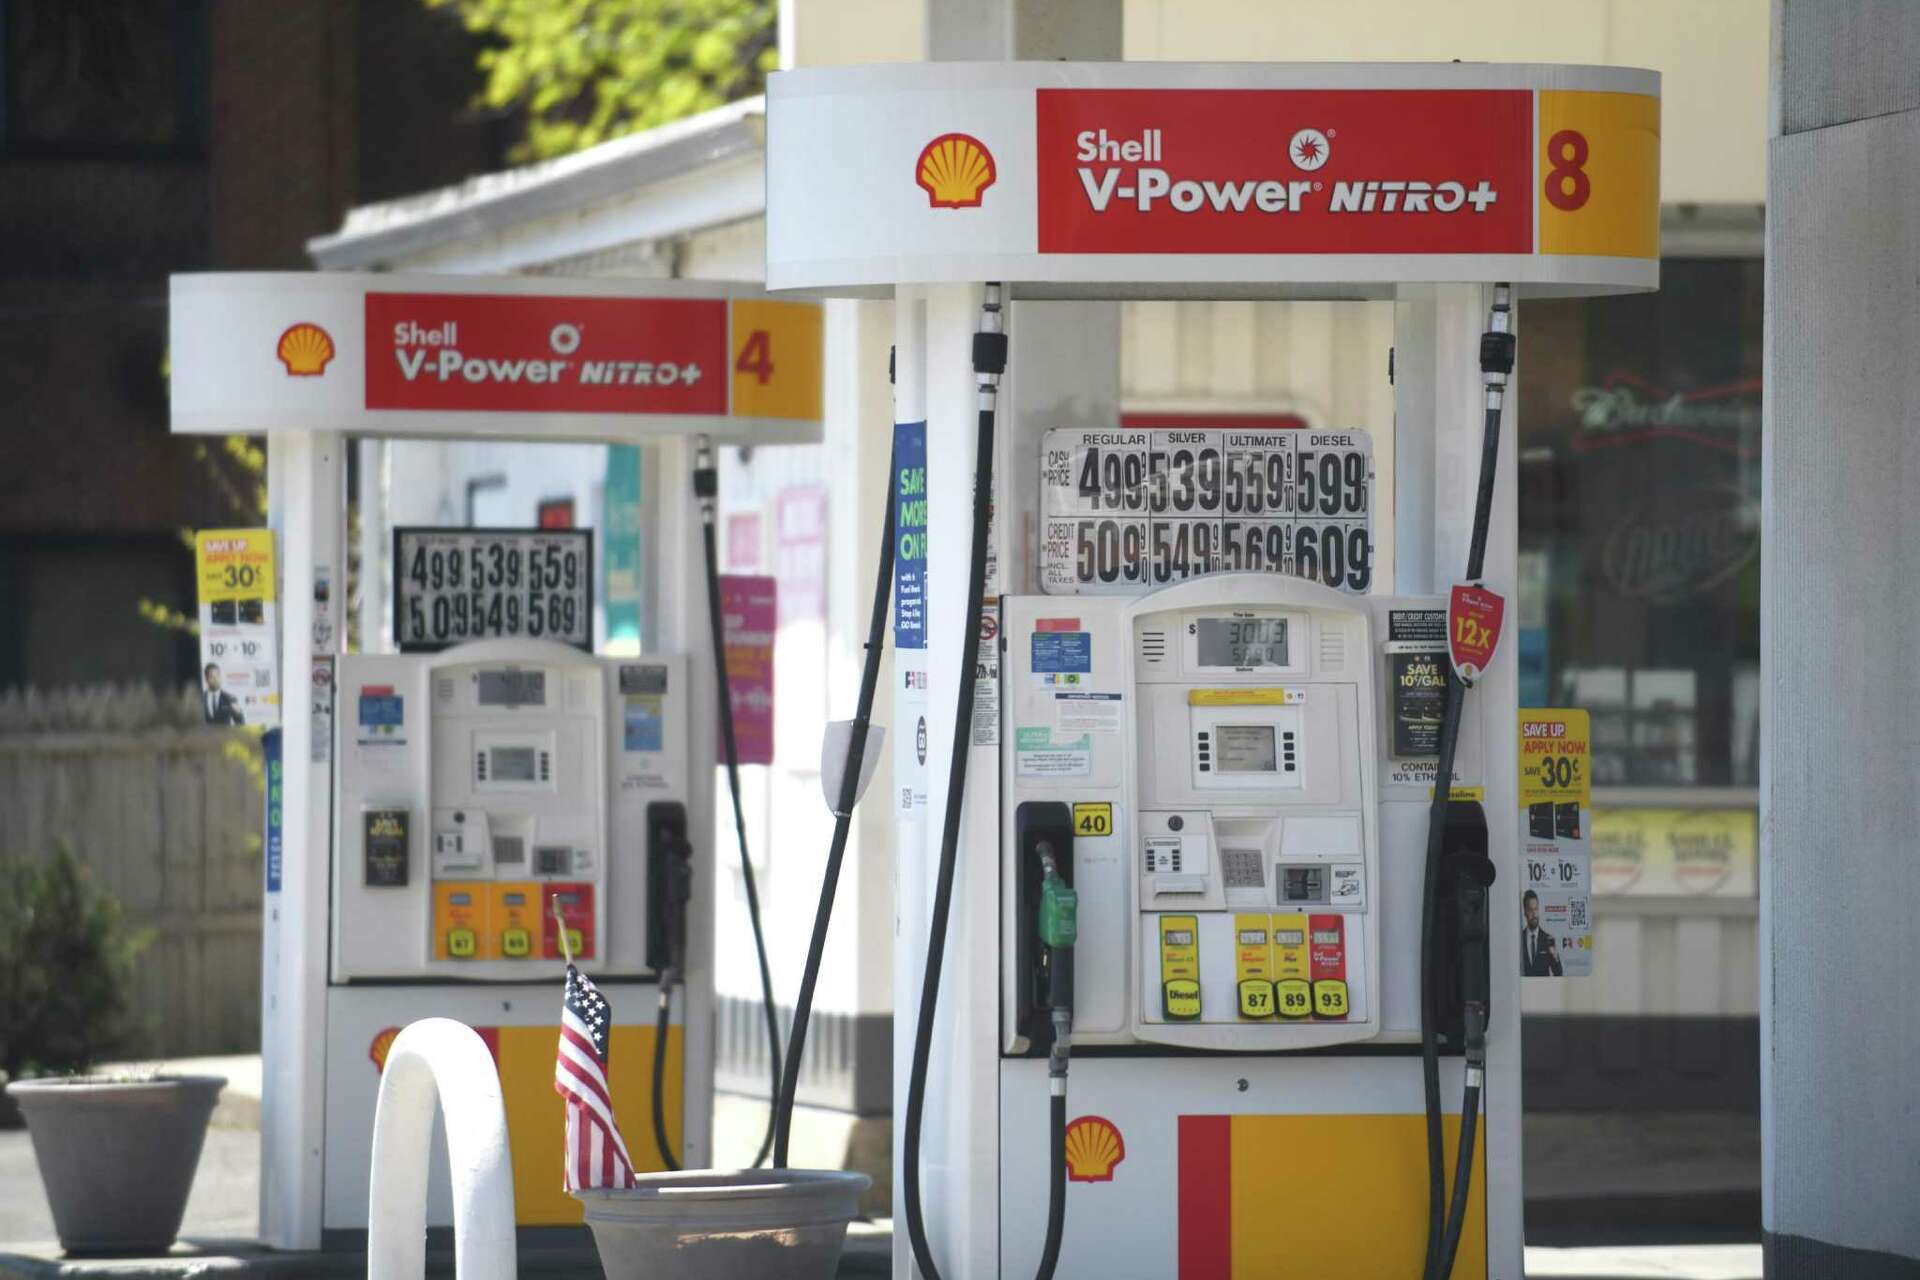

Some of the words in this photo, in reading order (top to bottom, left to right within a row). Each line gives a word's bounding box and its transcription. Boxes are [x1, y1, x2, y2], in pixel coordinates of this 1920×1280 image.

[1077, 129, 1161, 161] Shell
[1545, 129, 1590, 211] 8
[1077, 167, 1312, 212] V-Power
[394, 321, 457, 345] Shell
[736, 329, 774, 385] 4
[396, 349, 567, 383] V-Power
[1083, 434, 1146, 445] REGULAR
[1168, 432, 1206, 443] SILVER
[1230, 436, 1287, 446] ULTIMATE
[1310, 435, 1354, 446] DIESEL
[1048, 450, 1070, 468] CASH
[1048, 468, 1070, 487] PRICE
[1048, 523, 1075, 540] CREDIT
[1048, 541, 1069, 558] PRICE
[1189, 624, 1196, 634] $
[1407, 664, 1438, 675] SAVE
[1523, 723, 1547, 737] SAVE
[1550, 723, 1565, 737] UP
[1524, 741, 1553, 753] APPLY
[1558, 741, 1586, 753] NOW
[1080, 815, 1105, 832] 40
[1169, 989, 1199, 1000] Diesel
[1248, 993, 1268, 1007] 87
[1285, 993, 1306, 1007] 89
[1322, 993, 1342, 1007] 93
